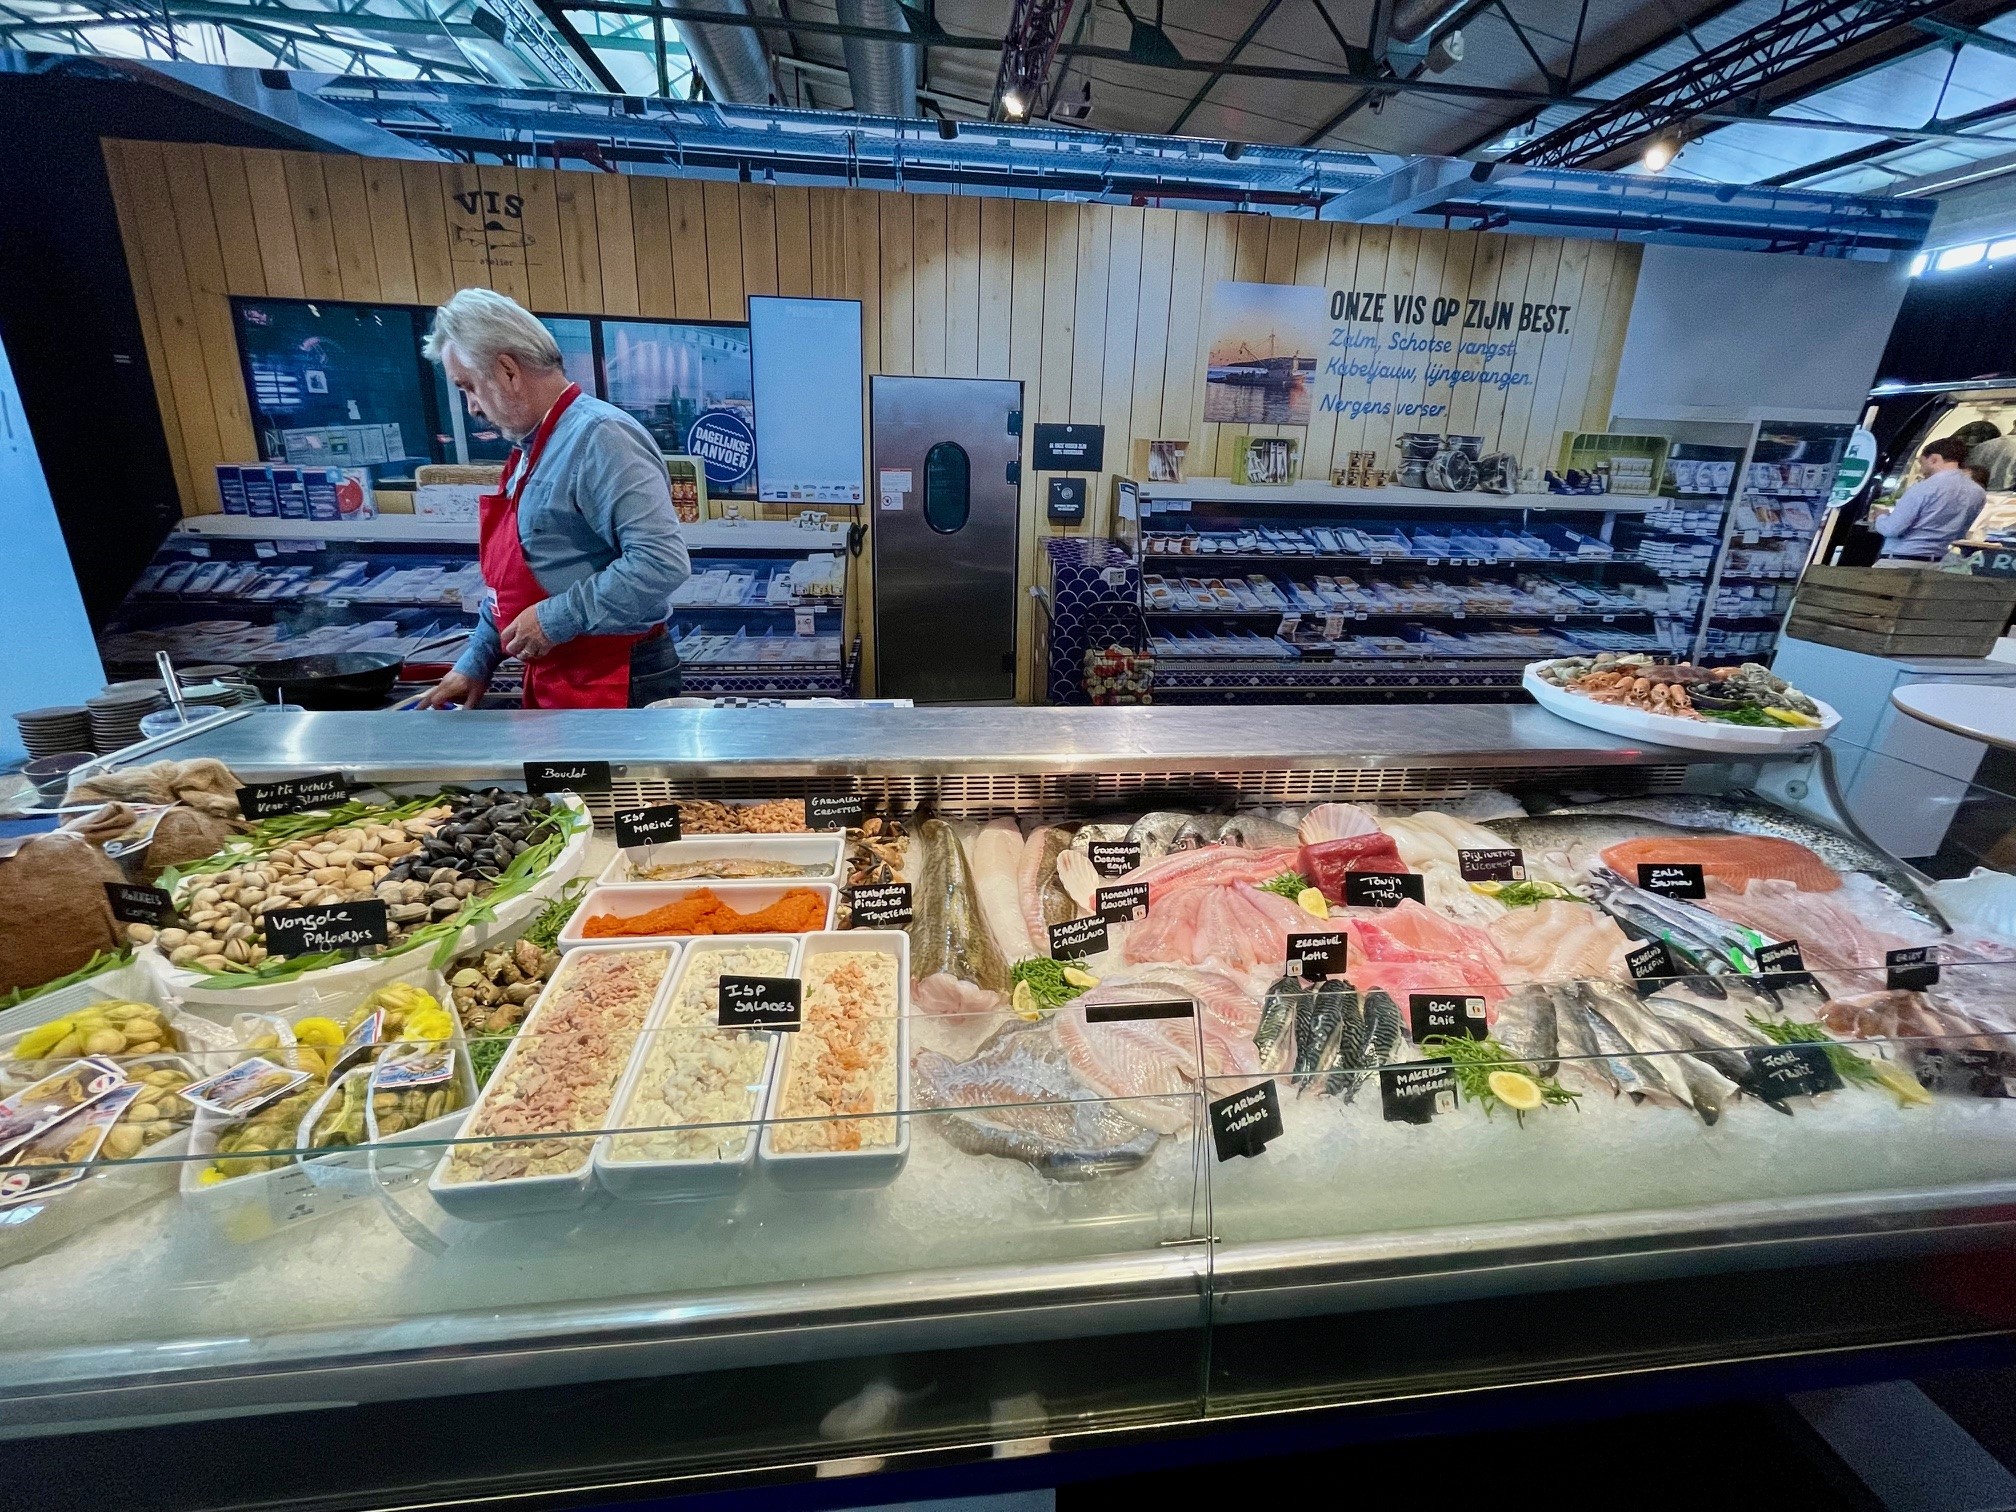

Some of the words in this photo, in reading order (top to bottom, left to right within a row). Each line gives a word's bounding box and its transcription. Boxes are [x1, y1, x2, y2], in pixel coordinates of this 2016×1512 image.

[453, 190, 525, 219] VIS
[479, 258, 513, 267] atelier
[1330, 290, 1387, 323] ONZE
[1393, 294, 1427, 325] VIS
[1431, 297, 1461, 327] OP
[1463, 299, 1514, 331] ZIJN
[1518, 303, 1572, 335] BEST.
[1328, 328, 1381, 350] Zalm,
[1388, 331, 1452, 353] Schotse
[1325, 357, 1417, 386] Kabeljauw,
[1319, 394, 1391, 420] Nergens
[1397, 402, 1448, 418] verser.
[695, 426, 751, 455] DAGELIJKSE
[692, 440, 748, 469] AANVOER
[734, 1000, 795, 1012] SALADES
[1428, 1001, 1456, 1012] ROG
[1396, 1066, 1447, 1086] MAKREEL
